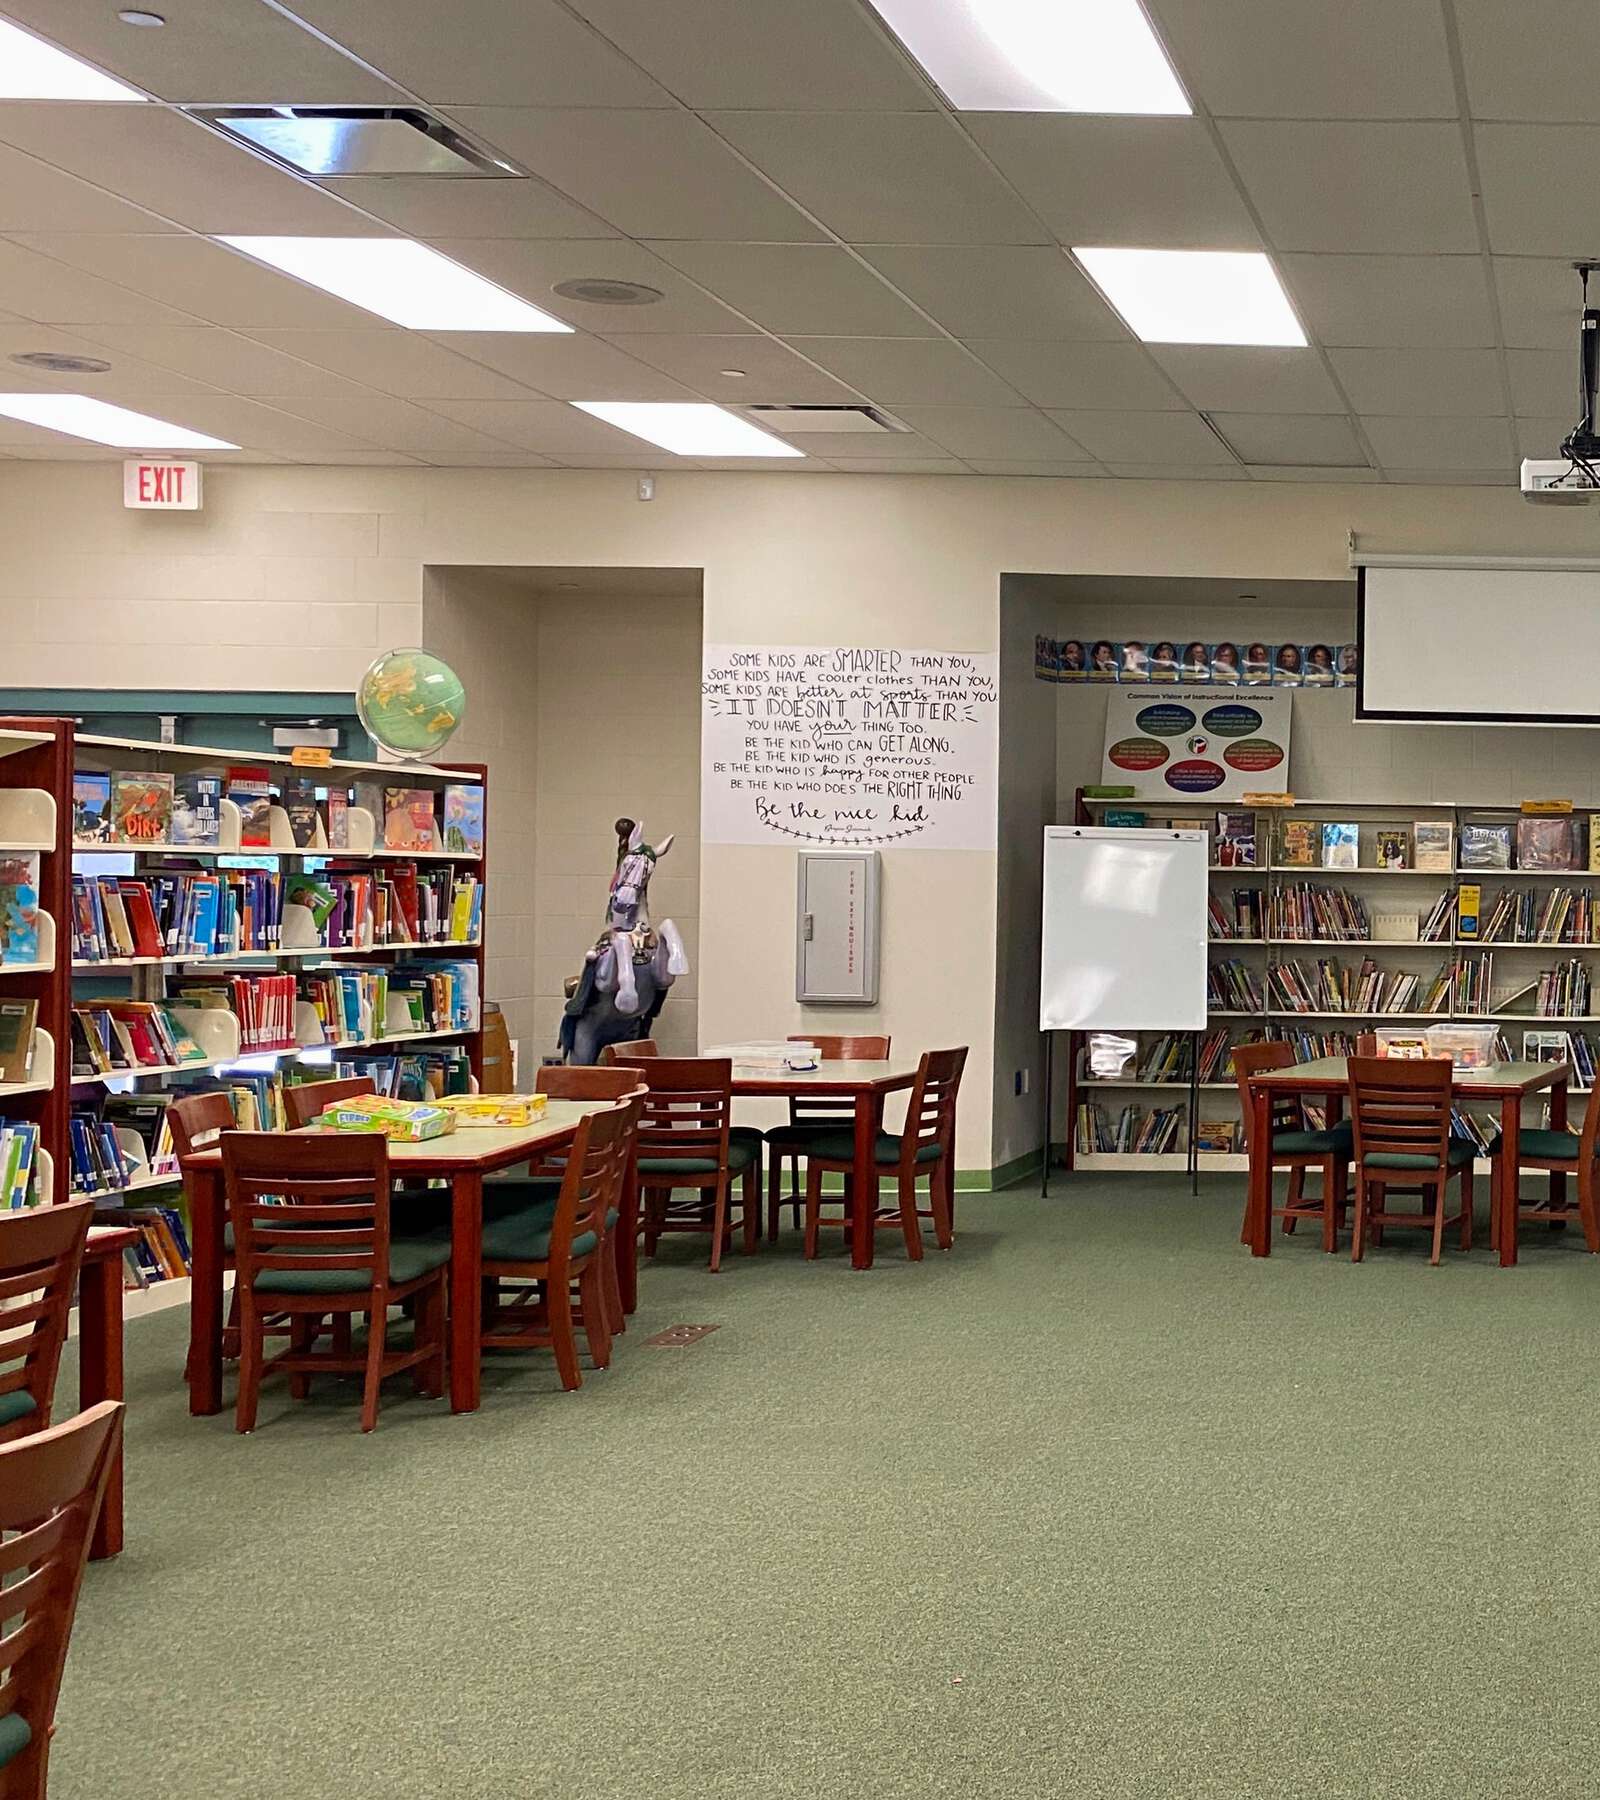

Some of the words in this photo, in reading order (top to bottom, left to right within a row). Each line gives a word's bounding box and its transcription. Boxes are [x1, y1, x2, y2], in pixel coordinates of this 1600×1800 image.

[139, 466, 186, 502] EXIT
[729, 653, 761, 667] SOME
[768, 654, 796, 667] KIDS
[804, 655, 826, 667] ARE
[832, 648, 901, 673] SMARTER
[911, 657, 943, 668] THAN
[947, 656, 976, 672] YOU,
[707, 669, 739, 680] SOME
[745, 671, 770, 682] KIDS
[777, 671, 807, 683] HAVE
[818, 674, 861, 683] cooler
[867, 675, 913, 685] clothes
[921, 675, 961, 686] THAN
[967, 676, 994, 690] YOU,
[701, 684, 730, 694] SOME
[736, 685, 762, 696] KIDS
[767, 686, 789, 697] ARE
[797, 686, 843, 699] better
[850, 686, 872, 699] at
[880, 688, 931, 702] sports
[936, 690, 967, 701] THAN
[725, 699, 757, 715] IT
[766, 699, 847, 718] DOESN'T
[864, 700, 964, 722] MATTER.
[747, 720, 769, 731] YOU
[774, 721, 802, 732] HAVE
[808, 719, 856, 740] your
[860, 722, 894, 732] THING
[900, 722, 927, 734] TOO.
[745, 737, 758, 747] BE
[763, 738, 784, 748] THE
[791, 739, 810, 749] KID
[815, 740, 843, 751] WHO
[848, 740, 872, 751] CAN
[879, 735, 905, 752] GET
[909, 736, 955, 753] ALONG.
[745, 751, 759, 761] BE
[766, 751, 785, 761] THE
[791, 752, 810, 763] KID
[814, 754, 840, 764] WHO
[845, 754, 856, 764] IS
[714, 762, 726, 772] BE
[730, 763, 751, 773] THE
[755, 765, 773, 774] KID
[776, 766, 800, 775] WHO
[805, 767, 815, 776] IS
[821, 765, 864, 782] happy
[869, 769, 889, 779] FOR
[893, 770, 929, 780] OTHER
[730, 779, 743, 789] BE
[748, 780, 767, 790] THE
[774, 782, 793, 791] KID
[796, 781, 821, 792] WHO
[825, 783, 856, 794] DOES
[863, 783, 884, 794] THE
[887, 781, 923, 800] RIGHT
[756, 796, 781, 820] Be
[788, 801, 826, 819] the
[834, 808, 877, 821] nice
